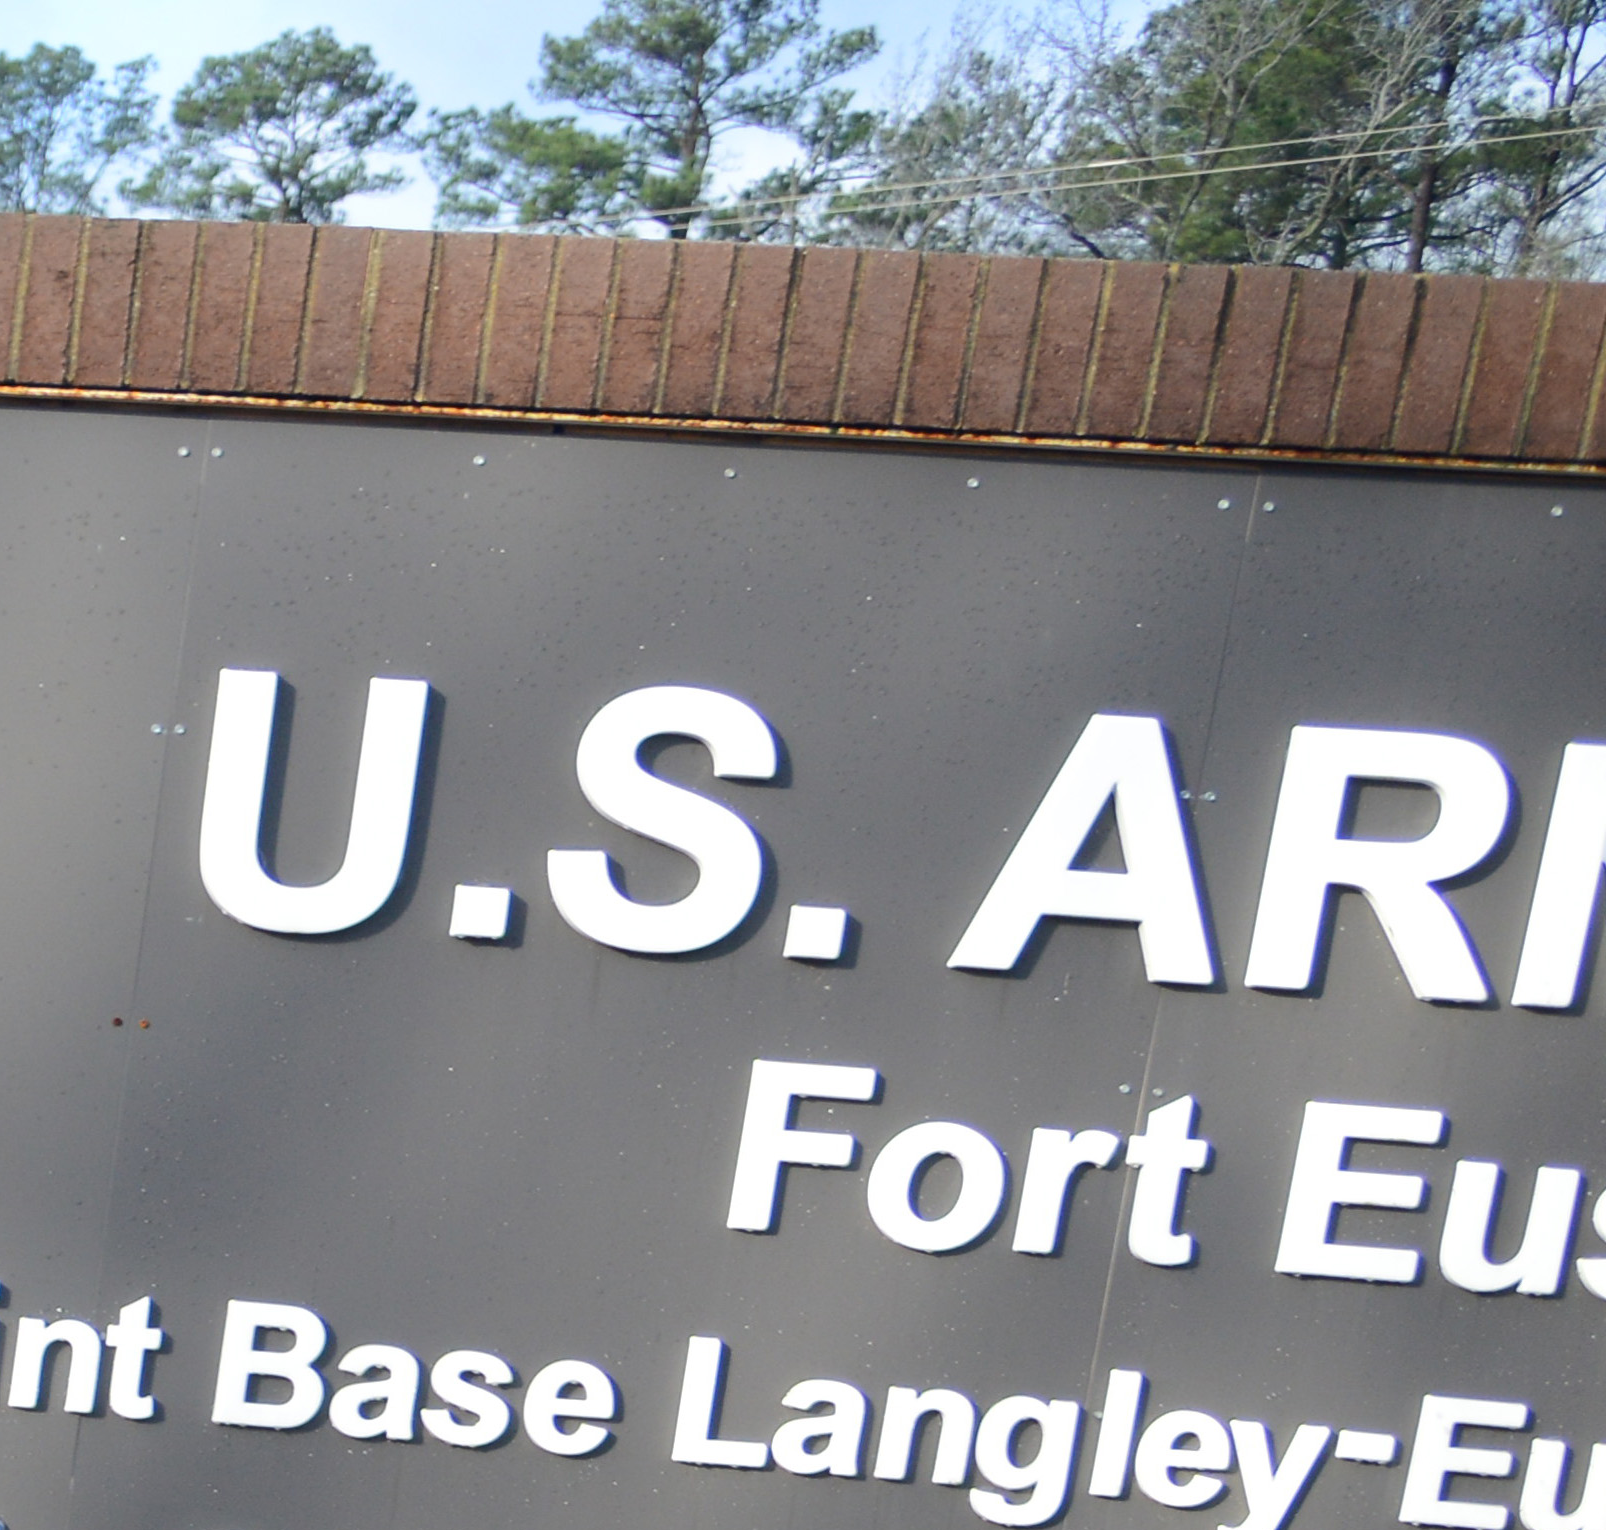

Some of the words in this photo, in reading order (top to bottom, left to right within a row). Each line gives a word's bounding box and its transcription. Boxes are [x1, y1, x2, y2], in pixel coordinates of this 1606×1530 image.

[198, 667, 848, 960] U.S.
[726, 1059, 1210, 1267] Fort
[1274, 1100, 1606, 1299] Eu
[211, 1299, 616, 1457] Base
